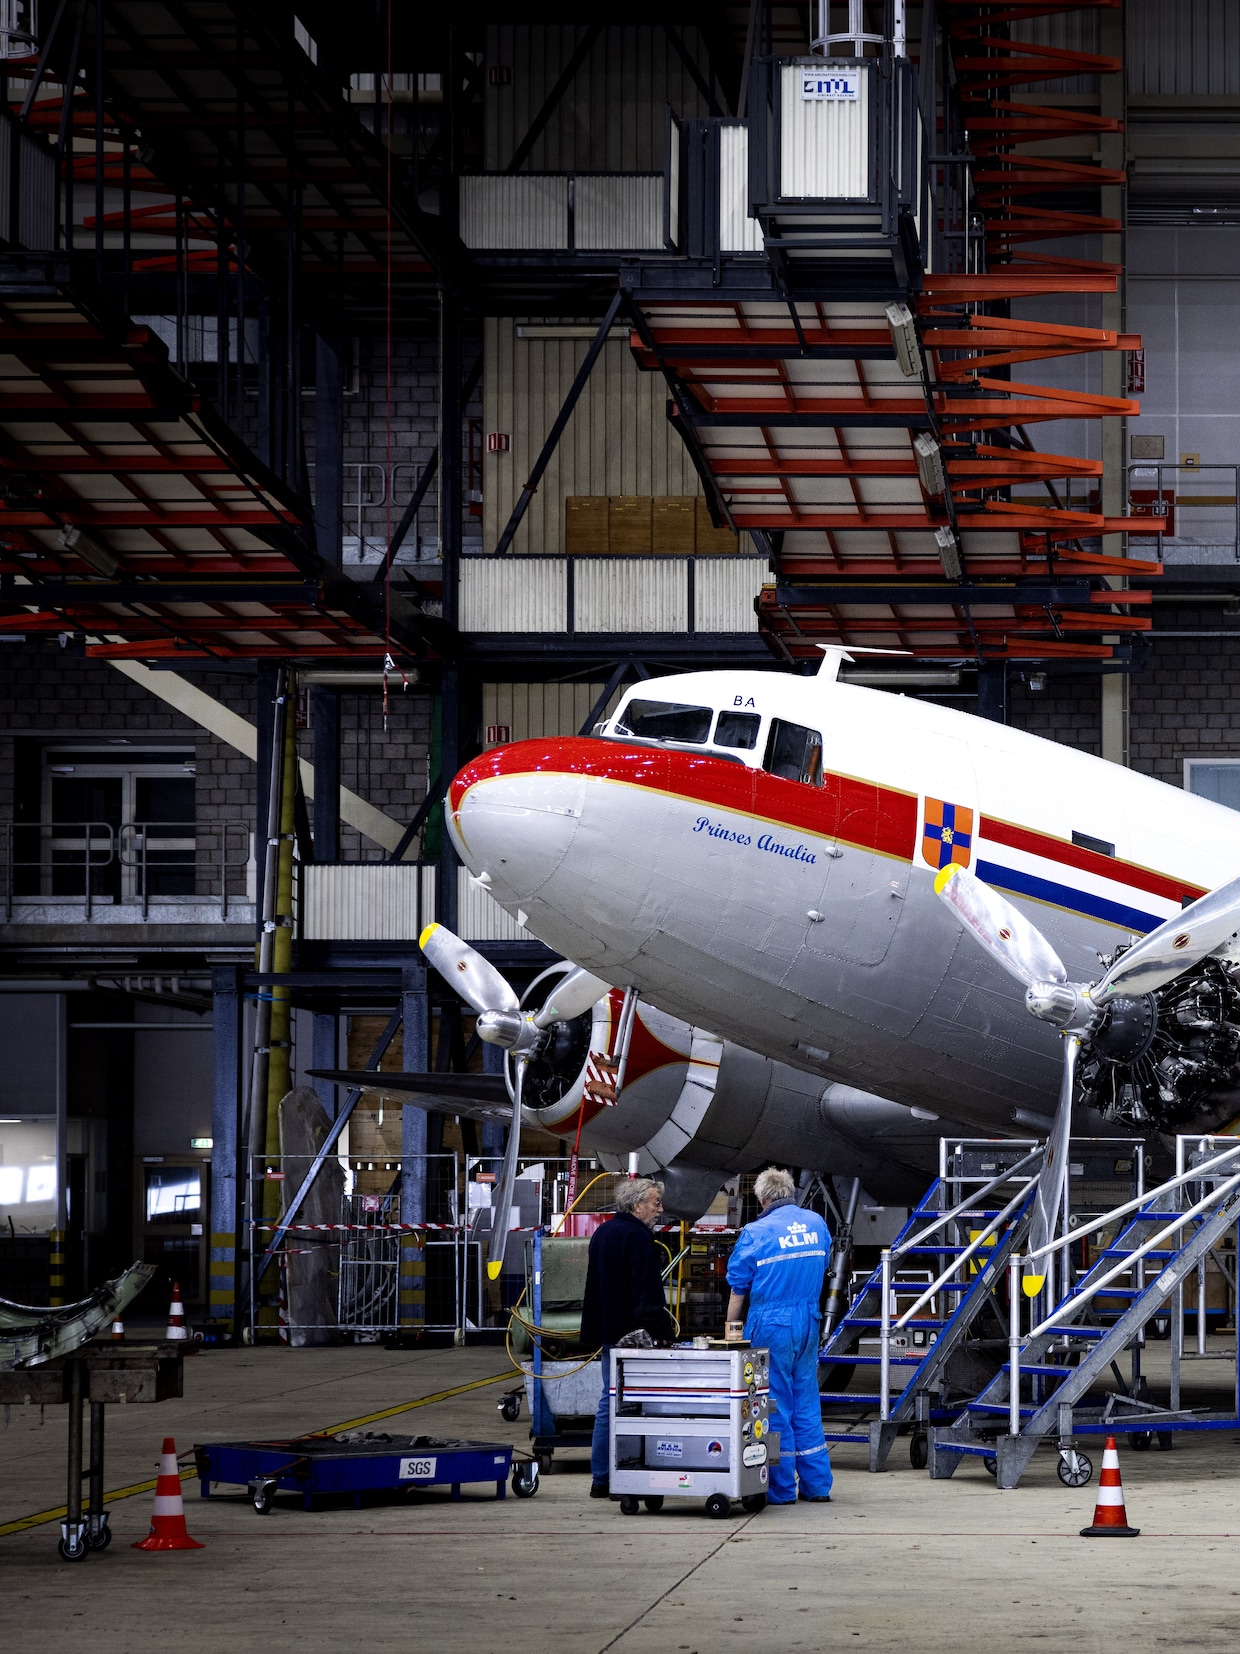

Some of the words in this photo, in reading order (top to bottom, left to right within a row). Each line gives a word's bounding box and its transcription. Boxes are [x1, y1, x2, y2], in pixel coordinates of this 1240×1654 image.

[692, 816, 752, 846] Prinses
[757, 834, 817, 864] Amalia
[779, 1232, 818, 1249] KLM
[407, 1462, 431, 1475] SGS
